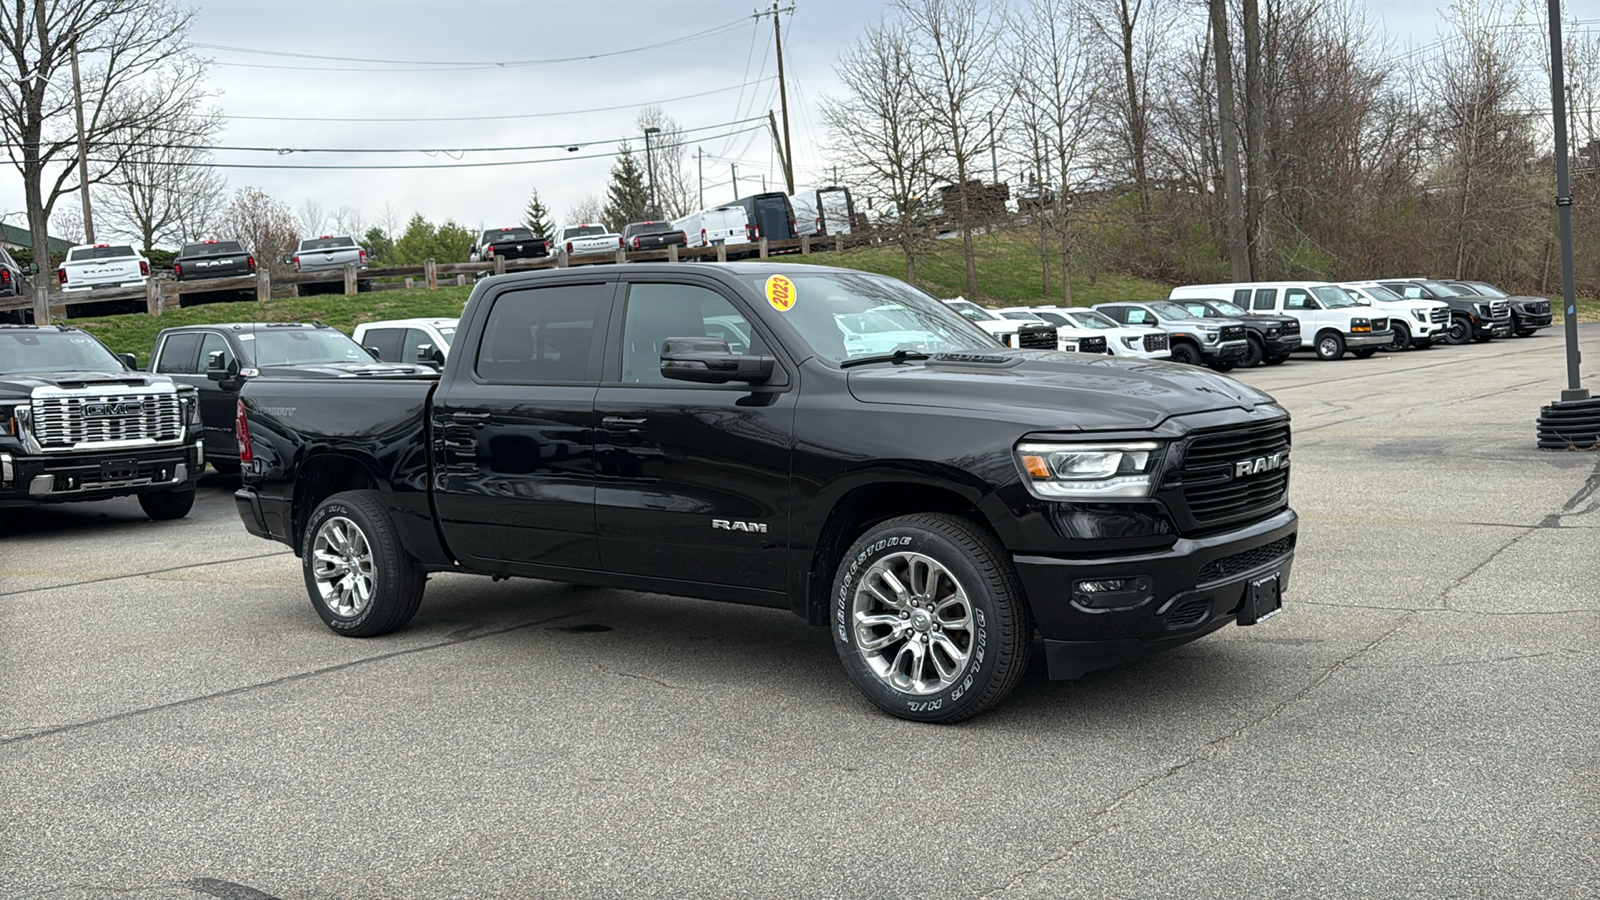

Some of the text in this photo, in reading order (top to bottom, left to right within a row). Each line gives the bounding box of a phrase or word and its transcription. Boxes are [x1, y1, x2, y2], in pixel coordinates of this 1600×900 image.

[196, 259, 233, 268] RAM
[772, 277, 789, 307] 2023
[86, 403, 141, 415] GMC
[1235, 453, 1280, 477] RAM
[712, 519, 767, 533] RAM
[837, 536, 912, 643] BRIDGESTONE
[951, 607, 987, 701] DUELER
